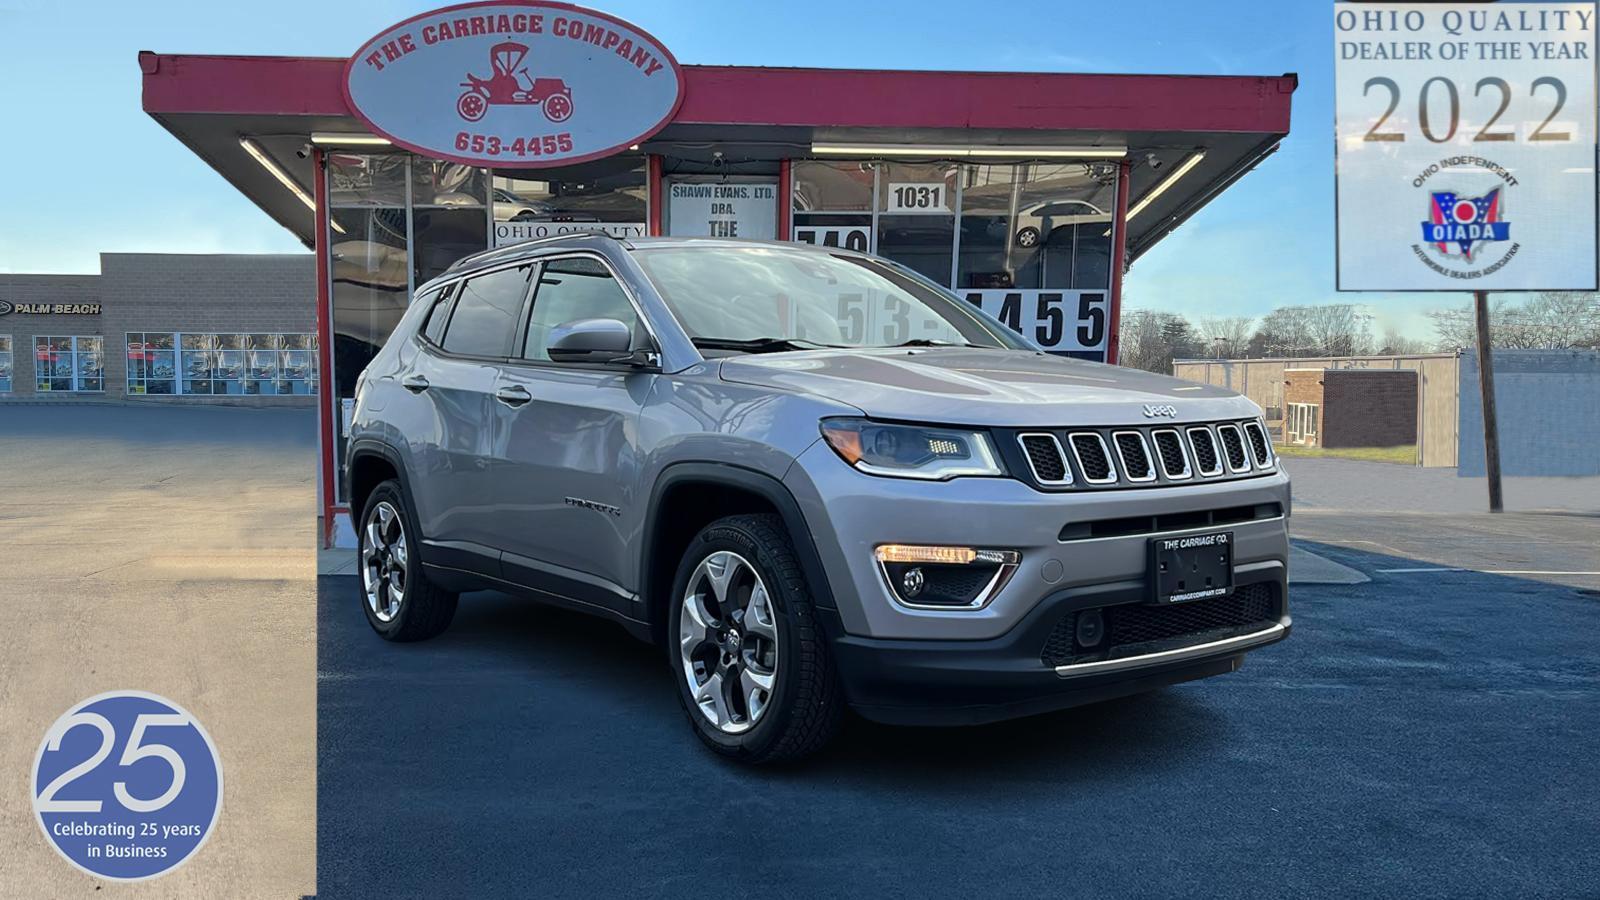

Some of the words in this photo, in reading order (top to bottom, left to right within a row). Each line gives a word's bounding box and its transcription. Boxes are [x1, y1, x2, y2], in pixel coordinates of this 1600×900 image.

[1336, 10, 1425, 31] OHIO
[1442, 10, 1592, 35] QUALITY
[364, 34, 416, 71] THE
[422, 14, 543, 45] CARRIAGE
[552, 17, 664, 77] COMPANY
[1340, 42, 1432, 60] DEALER
[1439, 42, 1469, 60] OF
[1475, 42, 1522, 60] THE
[1528, 42, 1589, 60] YEAR
[1362, 76, 1571, 143] 2022
[455, 132, 573, 156] 653-4455
[1413, 164, 1439, 188] OHIO
[1440, 155, 1519, 187] INDEPENDENT
[672, 186, 712, 199] SHAWN
[754, 187, 775, 199] LTD.
[895, 187, 940, 208] 1031
[711, 203, 736, 215] DBA.
[497, 226, 548, 238] OHIO
[709, 220, 738, 238] THE
[1432, 224, 1495, 240] OIADA
[1411, 244, 1449, 276] AUTOMOBILE
[1450, 270, 1482, 279] DEALERS
[1483, 242, 1520, 276] ASSOCIATION
[14, 303, 51, 314] PALM
[54, 303, 101, 314] BEACH
[1142, 403, 1177, 418] Jeep
[1164, 539, 1179, 550] THE
[1180, 535, 1215, 549] CARRIAGE
[1216, 534, 1228, 545] CO.
